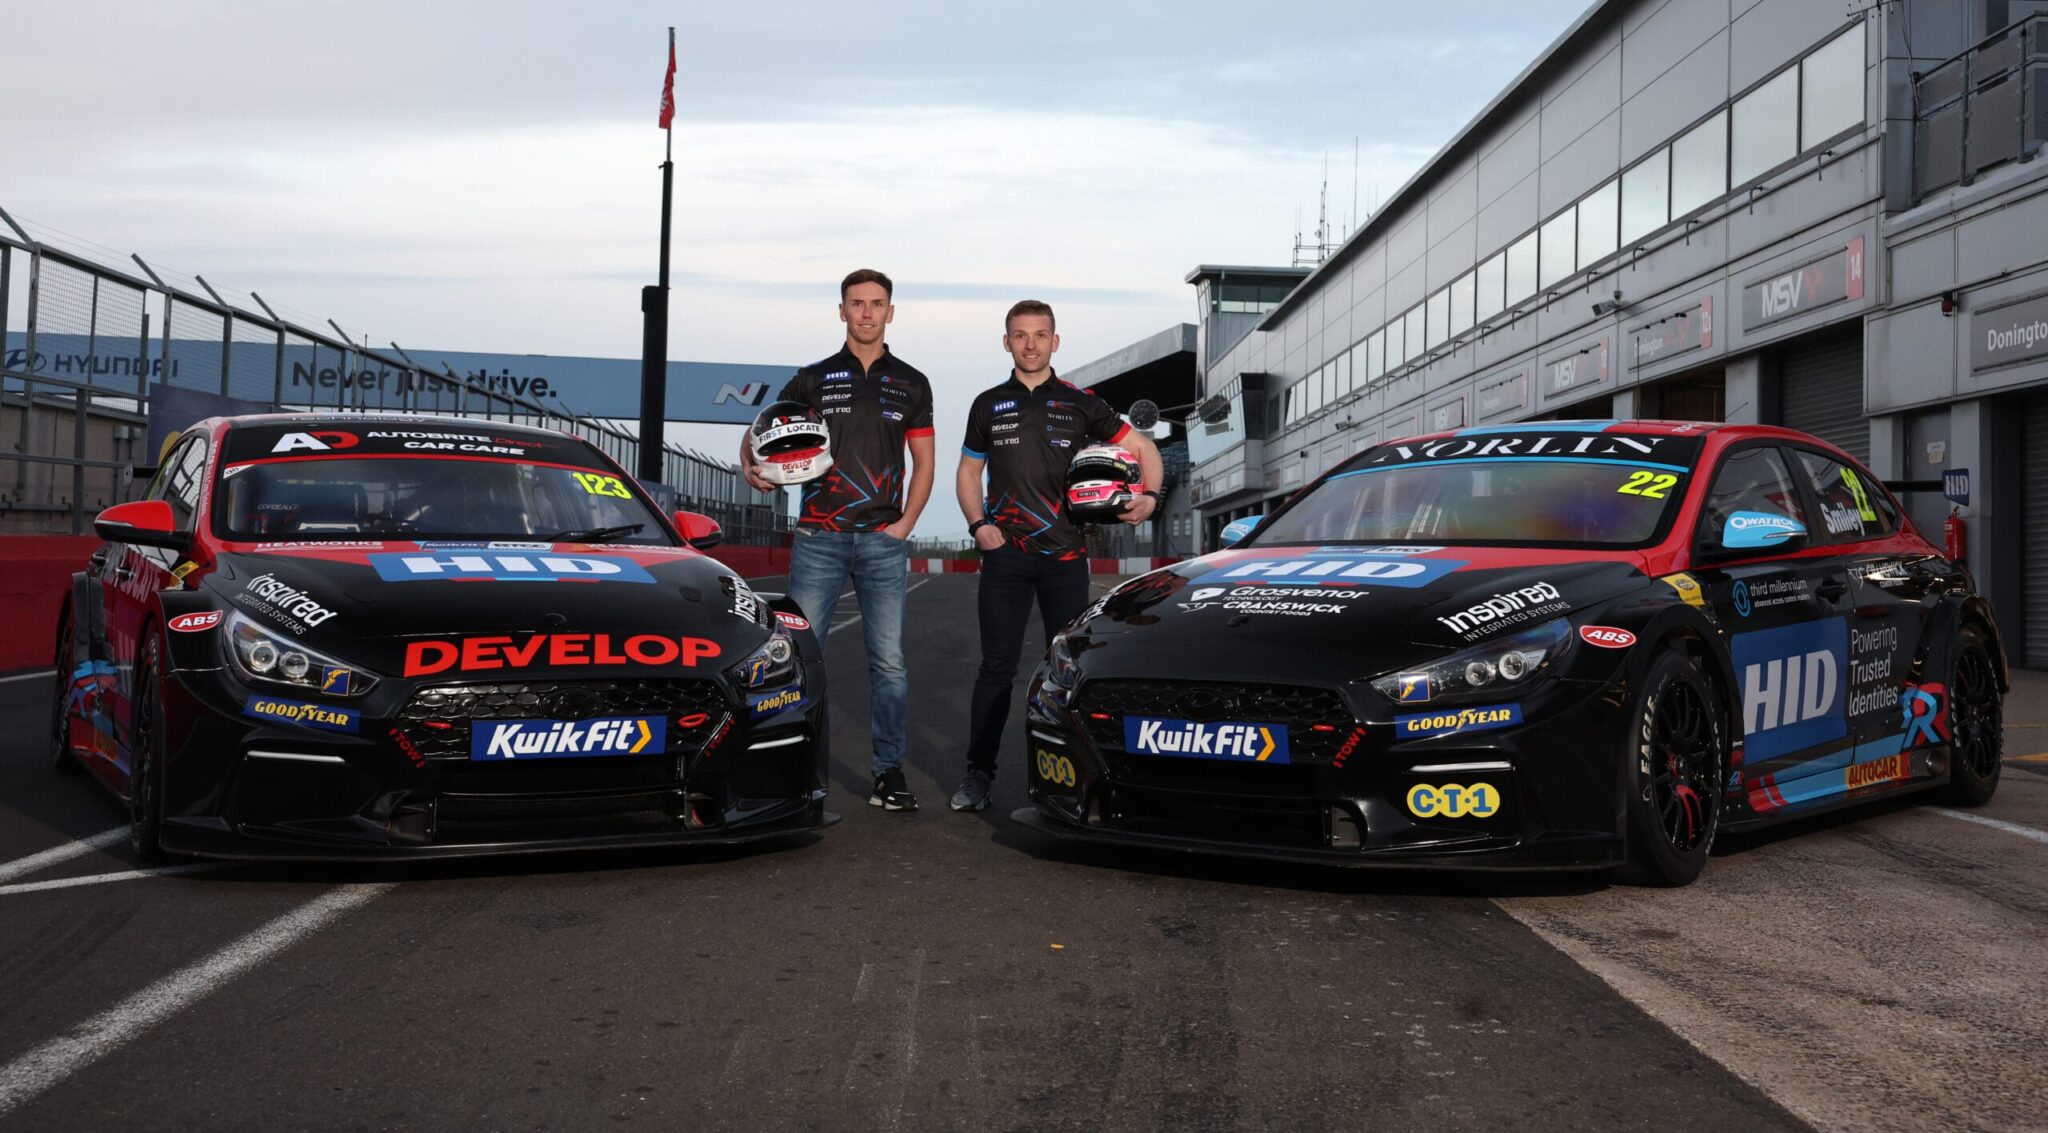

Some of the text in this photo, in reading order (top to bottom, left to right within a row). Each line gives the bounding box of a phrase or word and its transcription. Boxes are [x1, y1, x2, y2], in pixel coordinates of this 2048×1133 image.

[1850, 253, 1861, 281] 14
[1762, 270, 1803, 319] MSV
[1988, 320, 2048, 351] Doningto
[292, 361, 391, 390] Never
[826, 371, 849, 380] HID
[822, 393, 852, 402] DEVELOP
[994, 401, 1015, 412] HID
[367, 431, 493, 443] AUTOBRITE
[759, 424, 820, 443] FIRST LOCATE
[992, 422, 1019, 432] DEVELOP
[403, 441, 525, 456] CAR CARE
[1371, 437, 1665, 463] NORLIN
[782, 459, 812, 471] DEVELOP
[572, 472, 632, 499] 123
[1617, 470, 1678, 499] 22
[1820, 502, 1865, 536] Smiley
[401, 556, 622, 574] HID
[1223, 560, 1426, 578] HID
[1230, 586, 1370, 599] Grosvenor
[1750, 578, 1808, 596] third millennium
[1223, 601, 1348, 614] CRANSWICK
[178, 613, 218, 628] ABS
[270, 609, 306, 635] SYSTEMS
[776, 614, 804, 626] ABS
[1464, 601, 1571, 642] INTEGRATED SYSTEMS
[1587, 630, 1630, 643] ABS
[1851, 626, 1897, 654] Powering
[404, 634, 722, 678] DEVELOP
[1851, 653, 1891, 686] Trusted
[1743, 649, 1837, 735] HID
[1850, 685, 1899, 718] Identities
[255, 701, 349, 725] GOODYEAR
[1407, 709, 1511, 731] GOODYEAR
[1849, 757, 1898, 786] AUTOCAR
